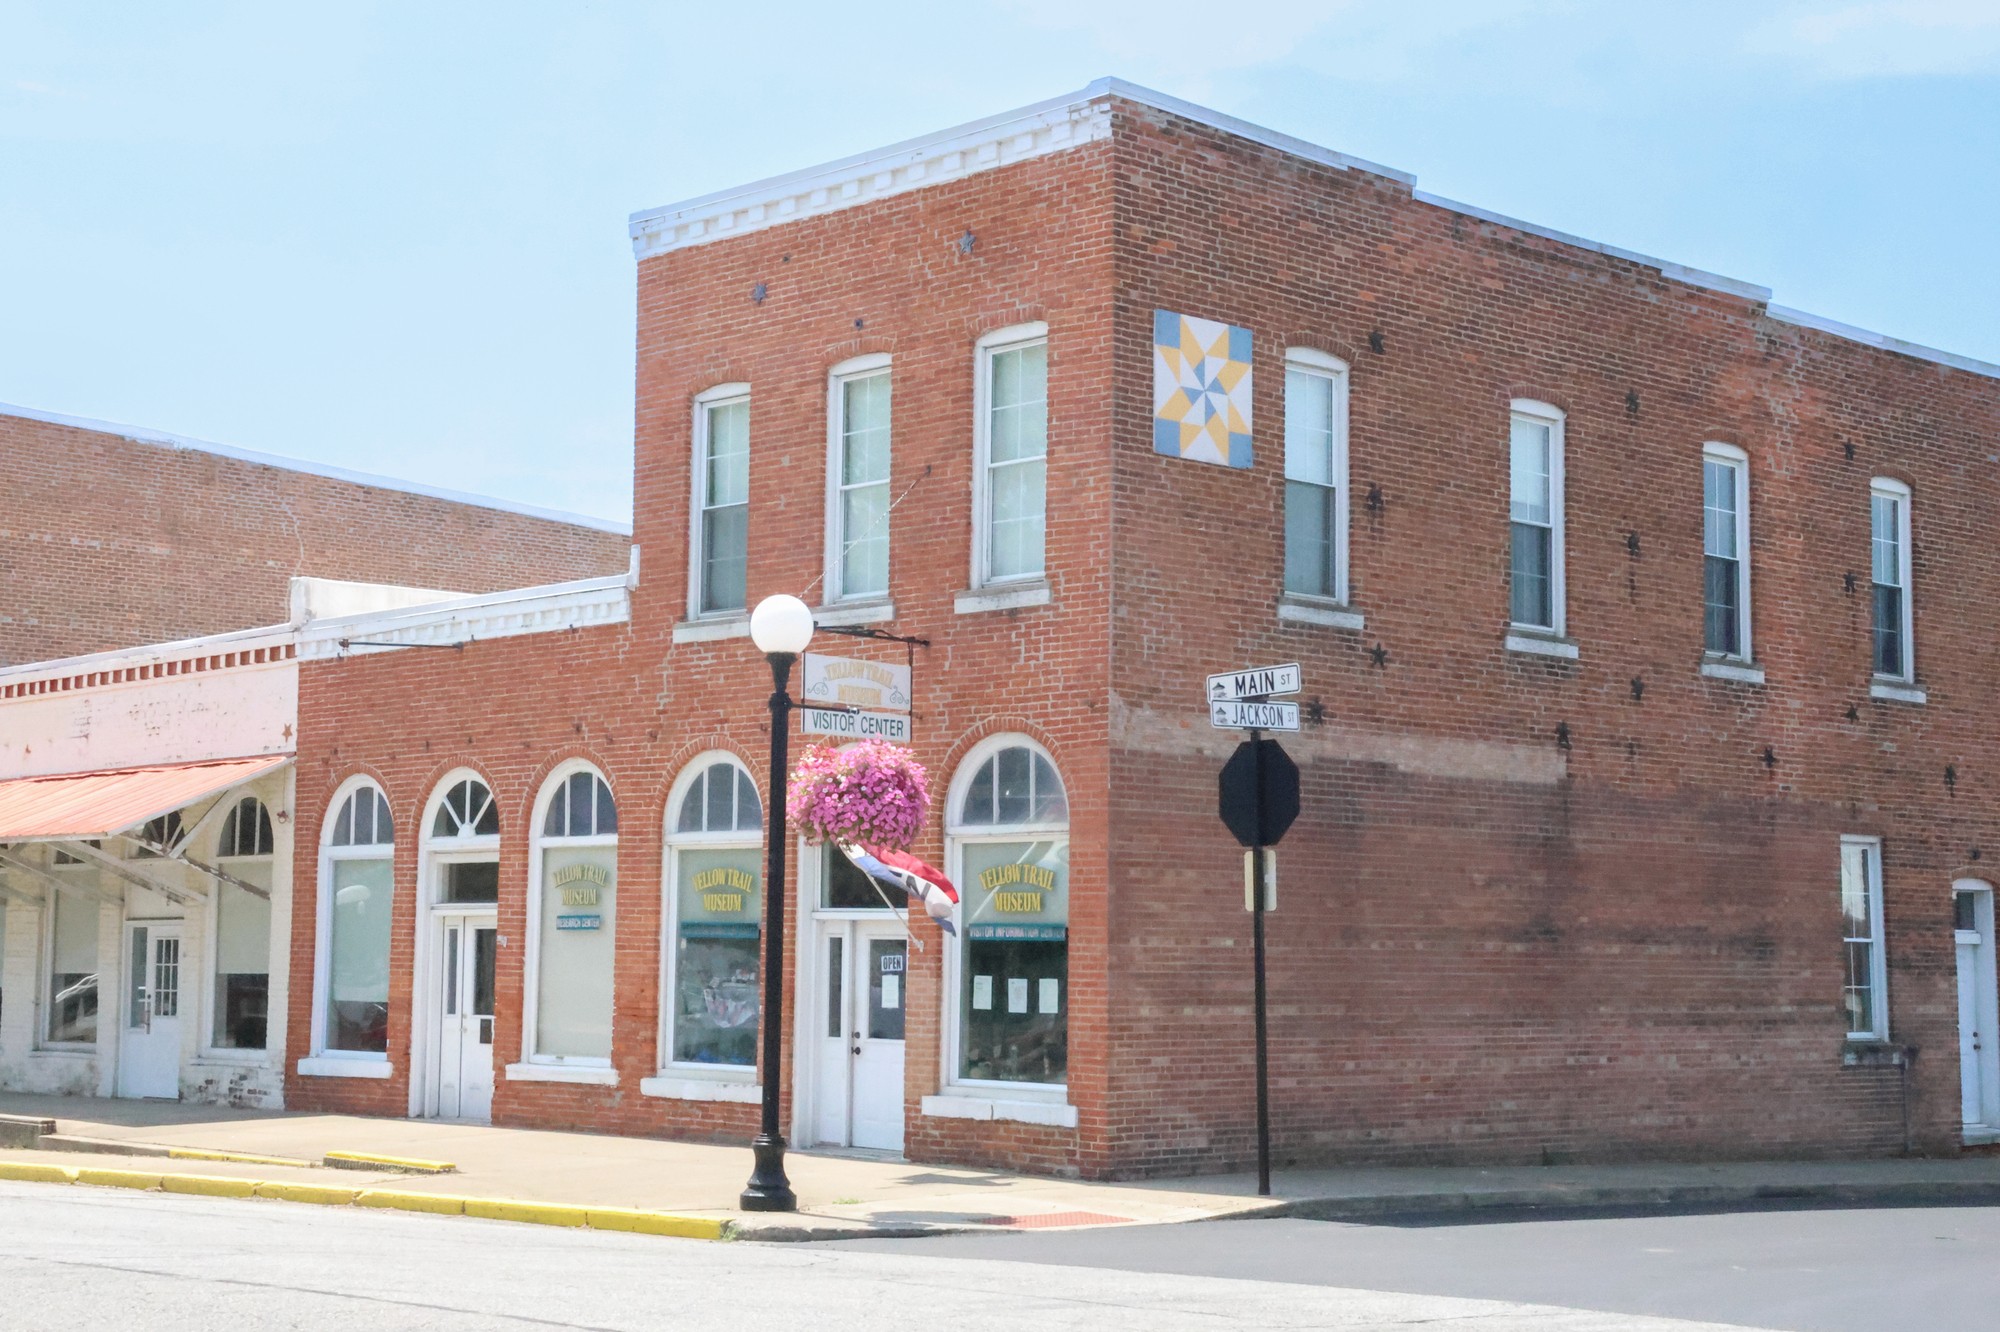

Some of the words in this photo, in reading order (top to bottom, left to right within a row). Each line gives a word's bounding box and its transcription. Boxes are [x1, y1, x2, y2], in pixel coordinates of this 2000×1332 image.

[1235, 671, 1275, 696] MAIN
[1280, 673, 1291, 686] ST
[812, 711, 856, 732] VISITOR
[860, 716, 904, 737] CENTER
[1232, 704, 1284, 726] JACKSON
[1287, 711, 1295, 722] ST
[553, 863, 582, 887] YELLOW
[583, 864, 607, 887] TRAIL
[692, 868, 726, 892] YELLOW
[727, 868, 753, 893] TRAIL
[979, 863, 1021, 890] YELLOW
[1022, 864, 1055, 891] TRAIL
[562, 888, 597, 905] MUSEUM
[703, 893, 742, 912] MUSEUM
[995, 891, 1041, 912] MUSEUM
[969, 926, 994, 937] VISITOR
[995, 926, 1039, 938] INFORMATION
[883, 956, 902, 970] OPEN
